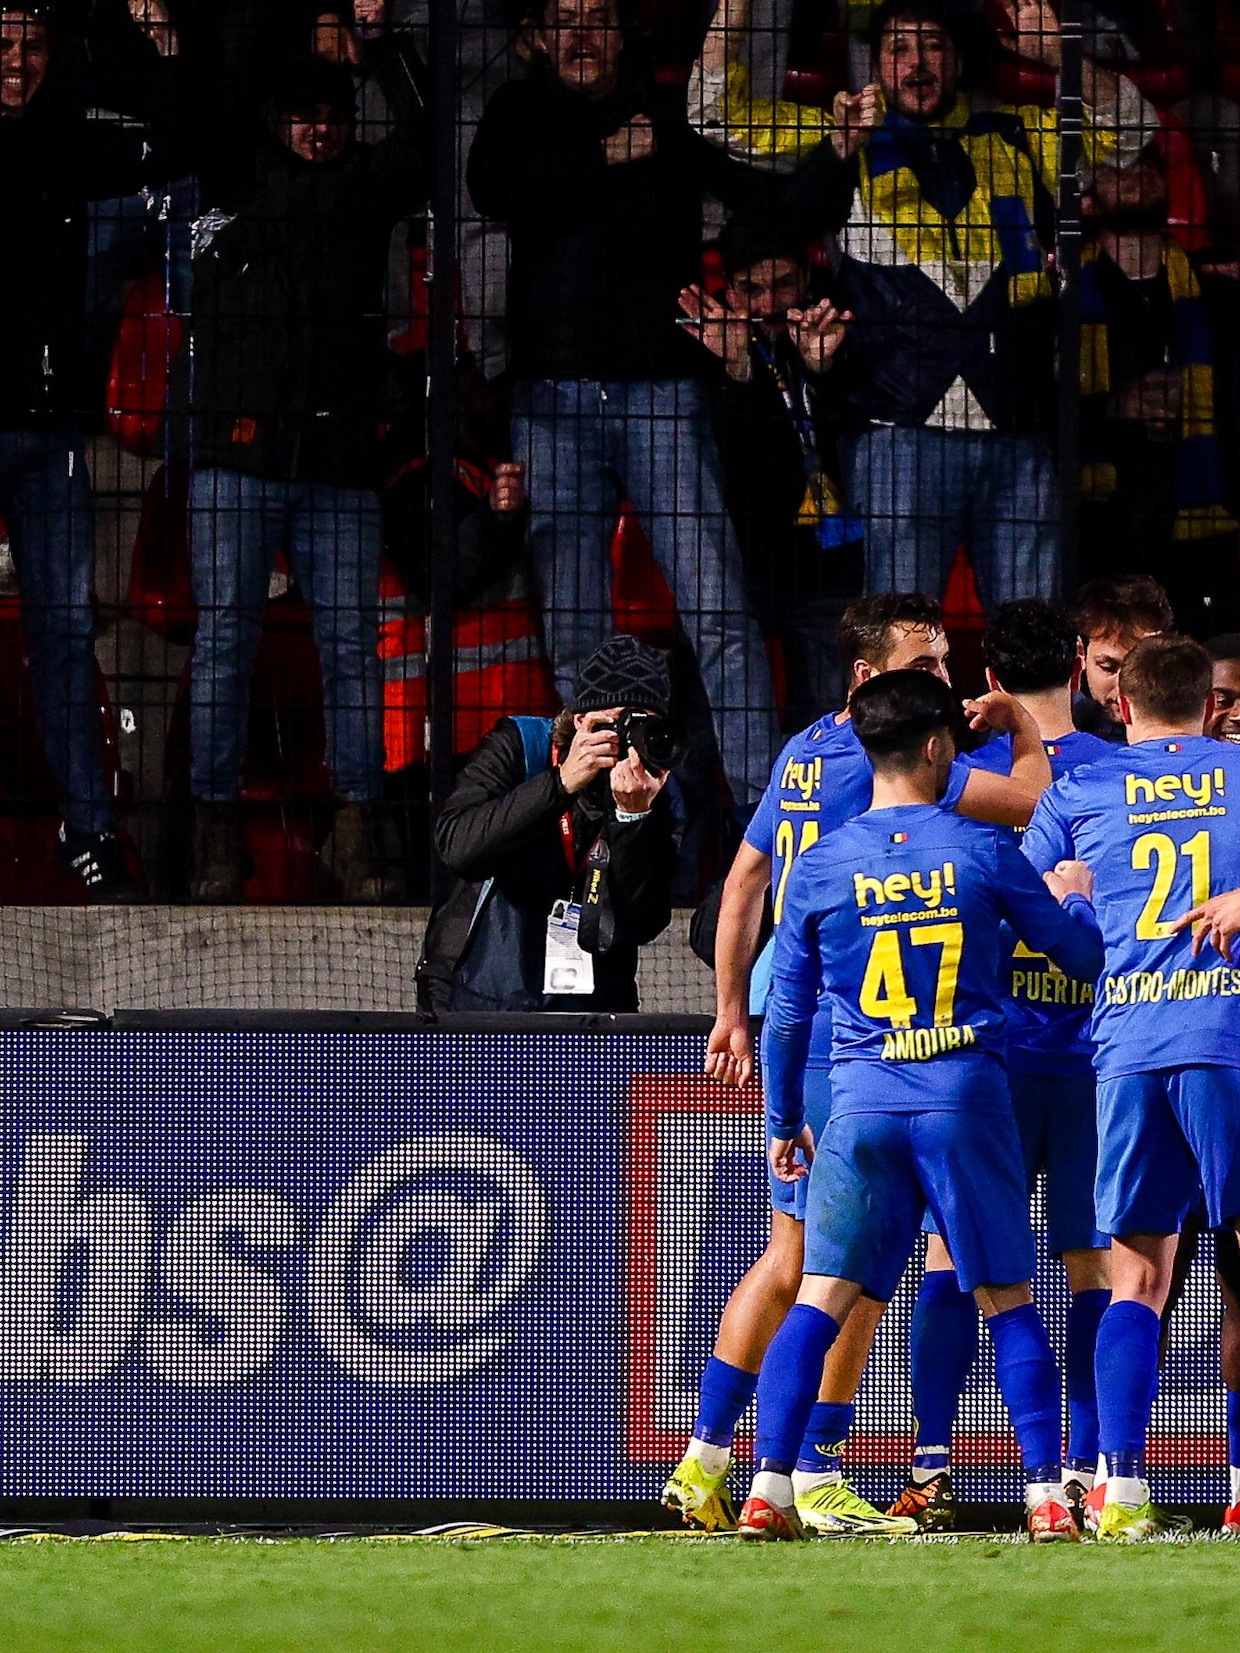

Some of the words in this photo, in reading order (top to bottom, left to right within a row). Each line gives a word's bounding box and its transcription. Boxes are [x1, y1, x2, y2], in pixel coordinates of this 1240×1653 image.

[780, 755, 822, 801] hey!
[1125, 767, 1225, 807] hey!
[1128, 806, 1227, 825] heytelecom.be
[586, 893, 599, 905] Z
[589, 868, 601, 893] Nikon
[852, 861, 956, 909] hey!
[1131, 830, 1211, 941] 21
[860, 906, 958, 927] heytelecom.be
[858, 921, 964, 1029] 47
[880, 1024, 976, 1061] AMOURA
